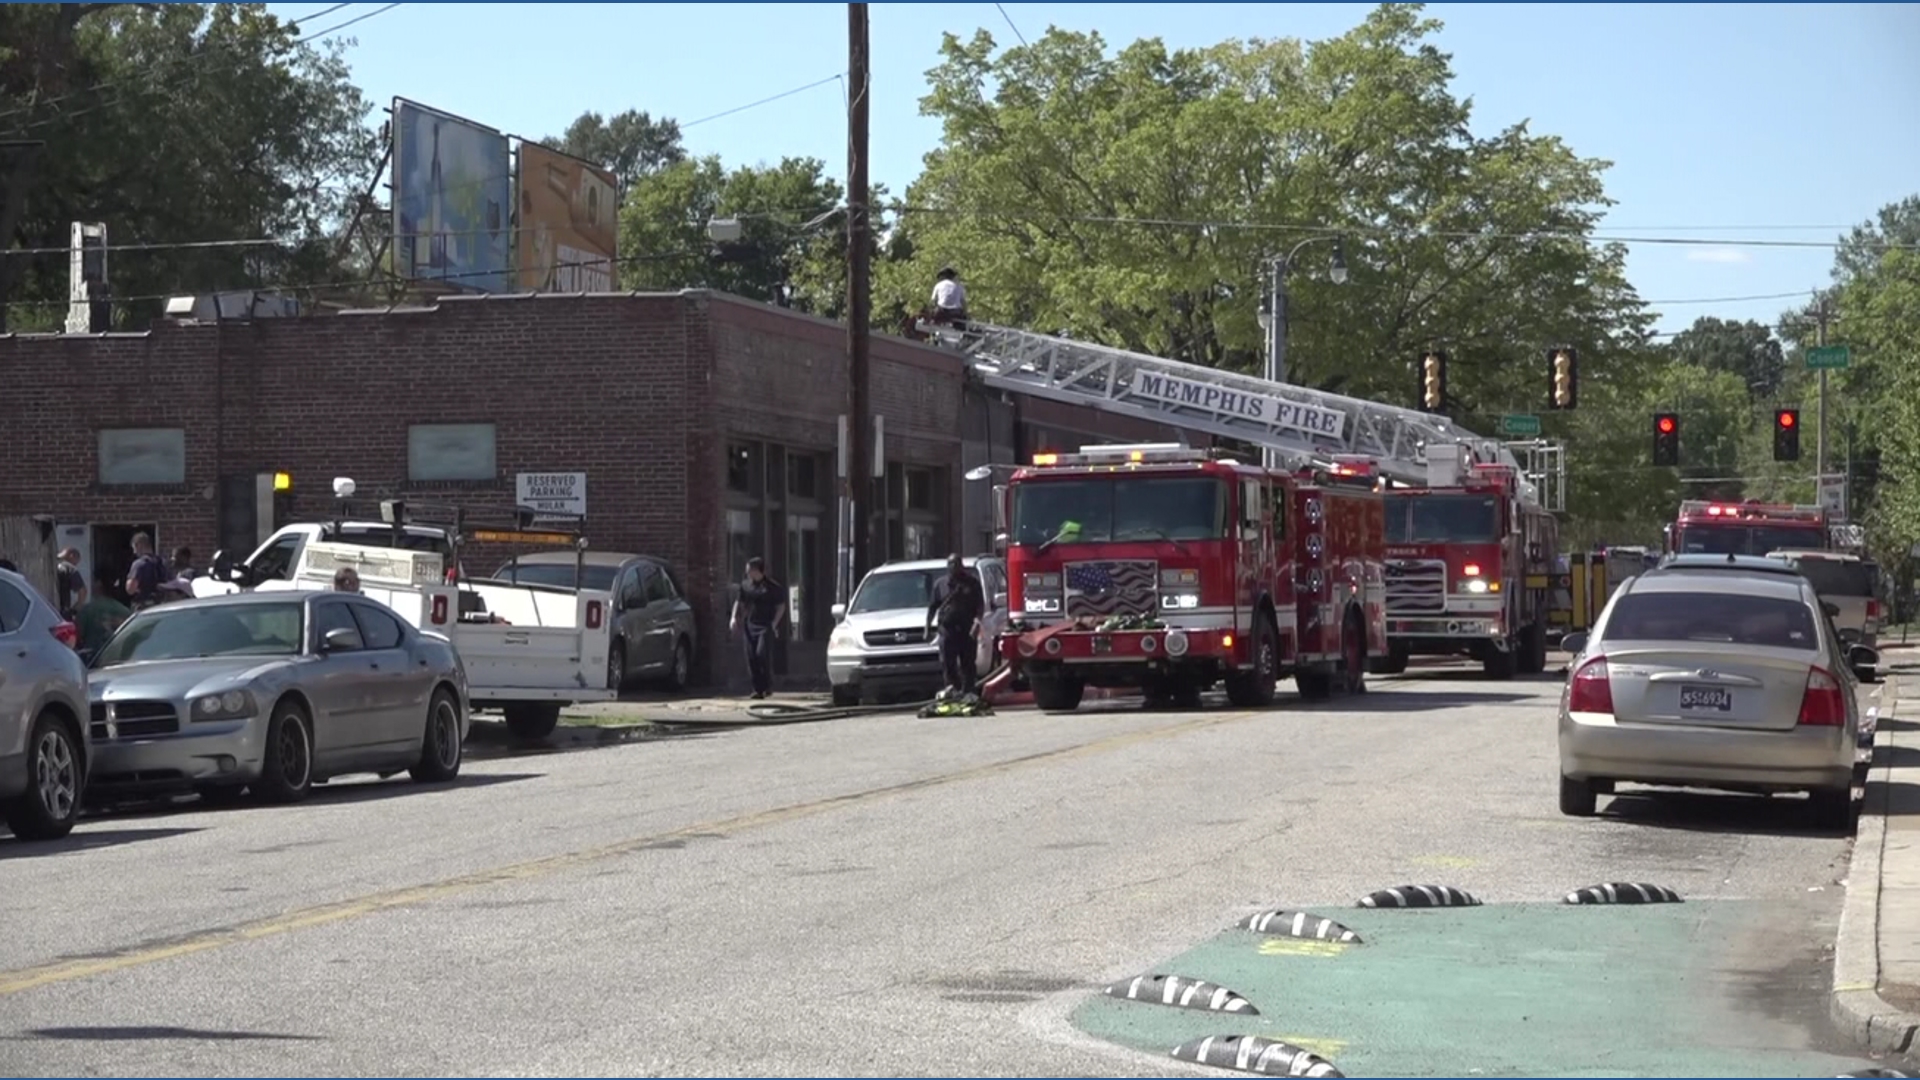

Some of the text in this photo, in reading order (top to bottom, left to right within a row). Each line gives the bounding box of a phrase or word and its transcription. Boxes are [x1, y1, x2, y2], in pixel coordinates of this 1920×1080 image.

[1140, 374, 1338, 434] MEMPHIS FIRE
[526, 475, 576, 486] RESERVED
[530, 486, 573, 497] PARKING
